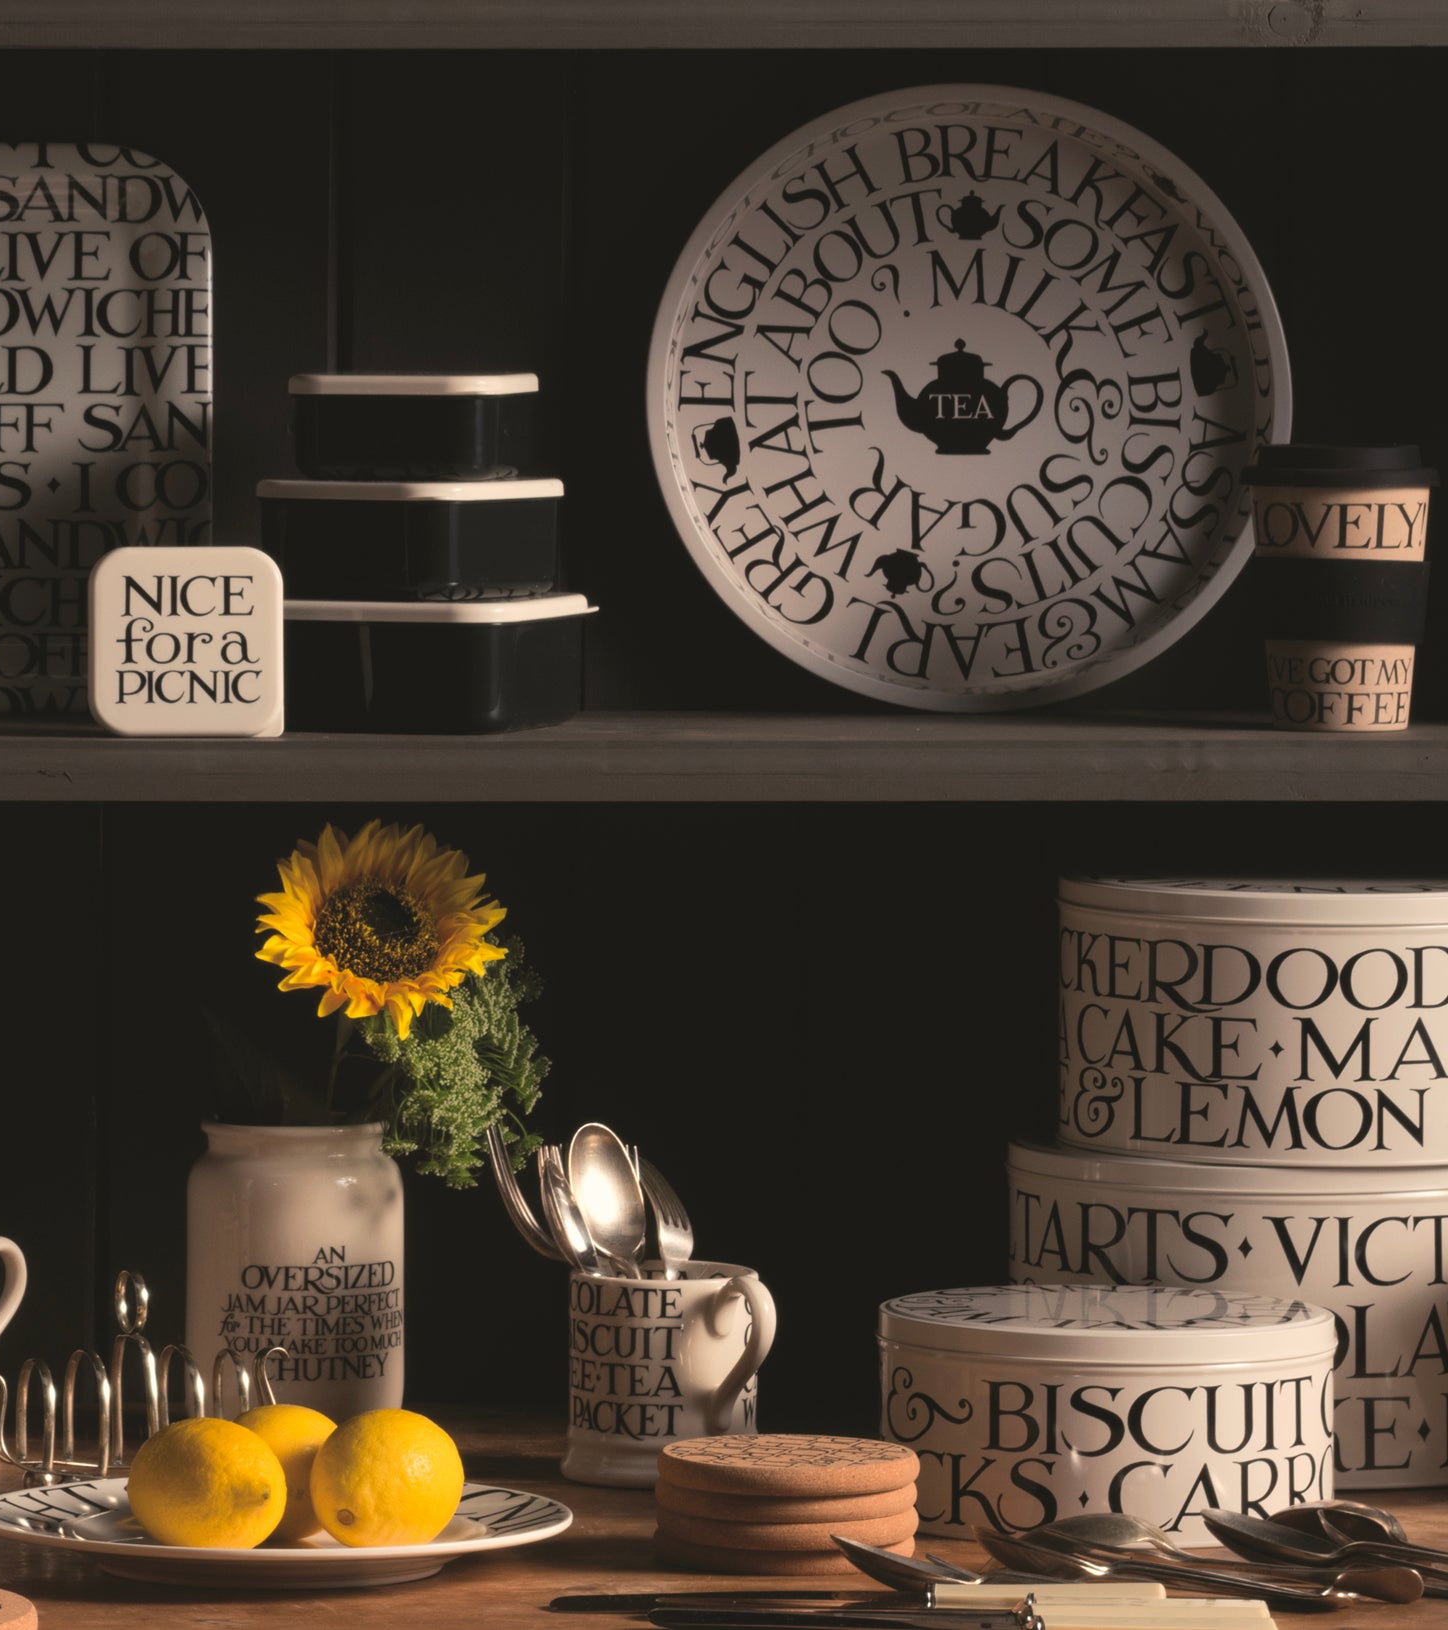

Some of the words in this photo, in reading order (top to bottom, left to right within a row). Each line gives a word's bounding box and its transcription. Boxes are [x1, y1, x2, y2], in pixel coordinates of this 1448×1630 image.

[129, 232, 208, 282] OF
[678, 142, 881, 413] ENGLISH
[890, 123, 1237, 335] BREAKFAST
[753, 187, 943, 366] ABOUT
[1001, 198, 1173, 358] SOME
[926, 247, 1105, 390] MILK
[77, 344, 208, 397] LIVE
[78, 402, 208, 453] SAN
[929, 392, 994, 420] TEA
[1053, 367, 1123, 466] &
[72, 462, 96, 512] I
[744, 369, 866, 581] WHAT
[848, 445, 1096, 557] SUGAR
[1094, 410, 1248, 632] ASSAM
[689, 475, 834, 626] GREY
[120, 575, 255, 617] NICE
[116, 617, 213, 664] for
[221, 630, 261, 665] a
[848, 595, 1042, 682] EARL
[1041, 597, 1102, 670] &
[115, 670, 262, 705] PICNIC
[1308, 657, 1374, 686] GOT
[1376, 657, 1412, 686] MY
[1272, 687, 1409, 726] COFFEE
[1077, 1003, 1263, 1083] CAKE
[1293, 1016, 1448, 1083] MA
[1074, 1066, 1125, 1138] &
[1127, 1074, 1432, 1152] LEMON
[313, 1245, 346, 1265] AN
[1017, 1189, 1236, 1285] TARTS
[1262, 1214, 1448, 1287] VICT
[220, 1293, 266, 1315] JAM
[269, 1295, 328, 1317] JAR
[326, 1288, 401, 1316] PERFECT
[241, 1261, 395, 1295] OVERSIZED
[217, 1313, 241, 1336] for
[245, 1315, 292, 1336] THE
[297, 1315, 366, 1337] TIMES
[224, 1335, 260, 1353] YOU
[329, 1335, 368, 1355] TOO
[370, 1331, 402, 1352] MUCH
[599, 1362, 683, 1398] TEA
[573, 1395, 683, 1441] PACKET
[888, 1366, 973, 1443] &
[981, 1375, 1313, 1457] BISCUIT
